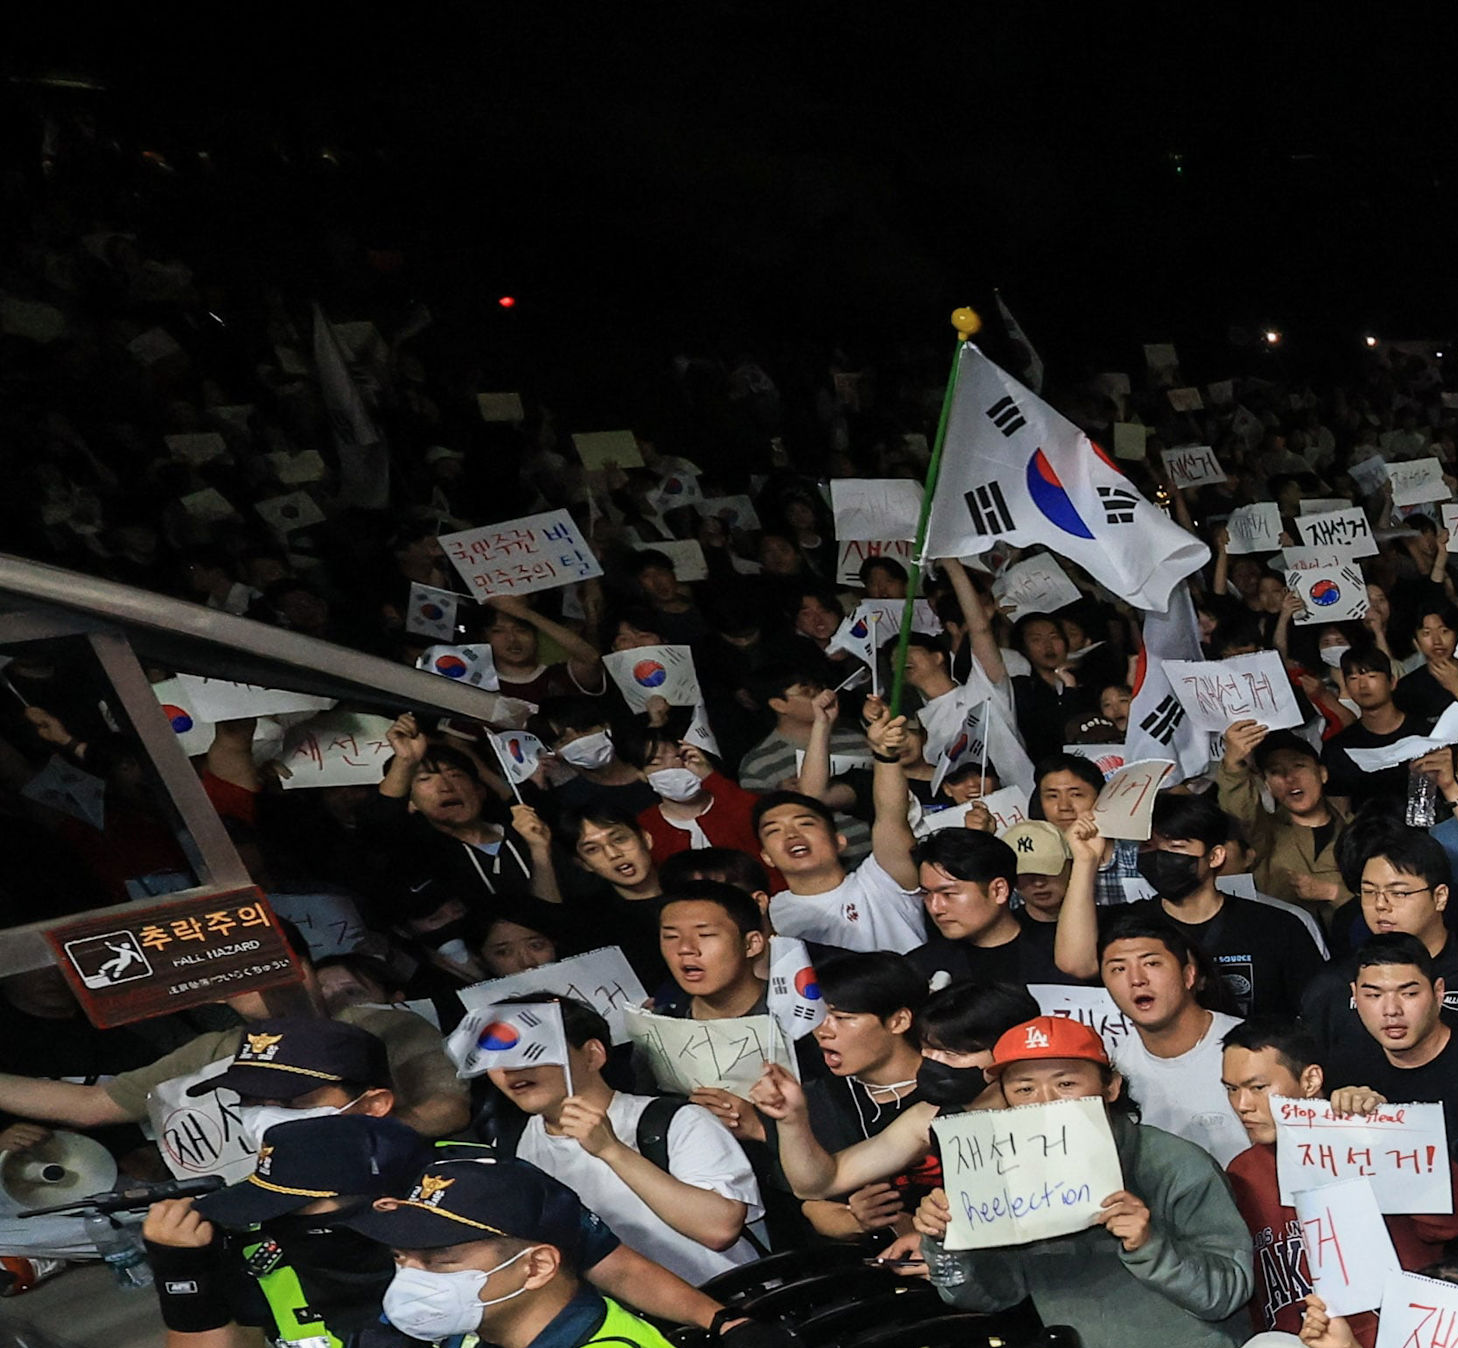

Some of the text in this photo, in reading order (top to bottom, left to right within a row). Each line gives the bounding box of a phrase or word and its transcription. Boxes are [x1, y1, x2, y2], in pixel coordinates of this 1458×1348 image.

[1305, 516, 1368, 546] 재선거
[473, 561, 557, 596] 민주주의
[1017, 836, 1034, 852] NY
[140, 901, 274, 952] 추락주의
[172, 939, 261, 969] FALL HAZARD
[1025, 1025, 1050, 1049] LA
[1280, 1104, 1317, 1129] Stop
[948, 1124, 1068, 1176] 재선거
[1296, 1143, 1437, 1178] 재선거!
